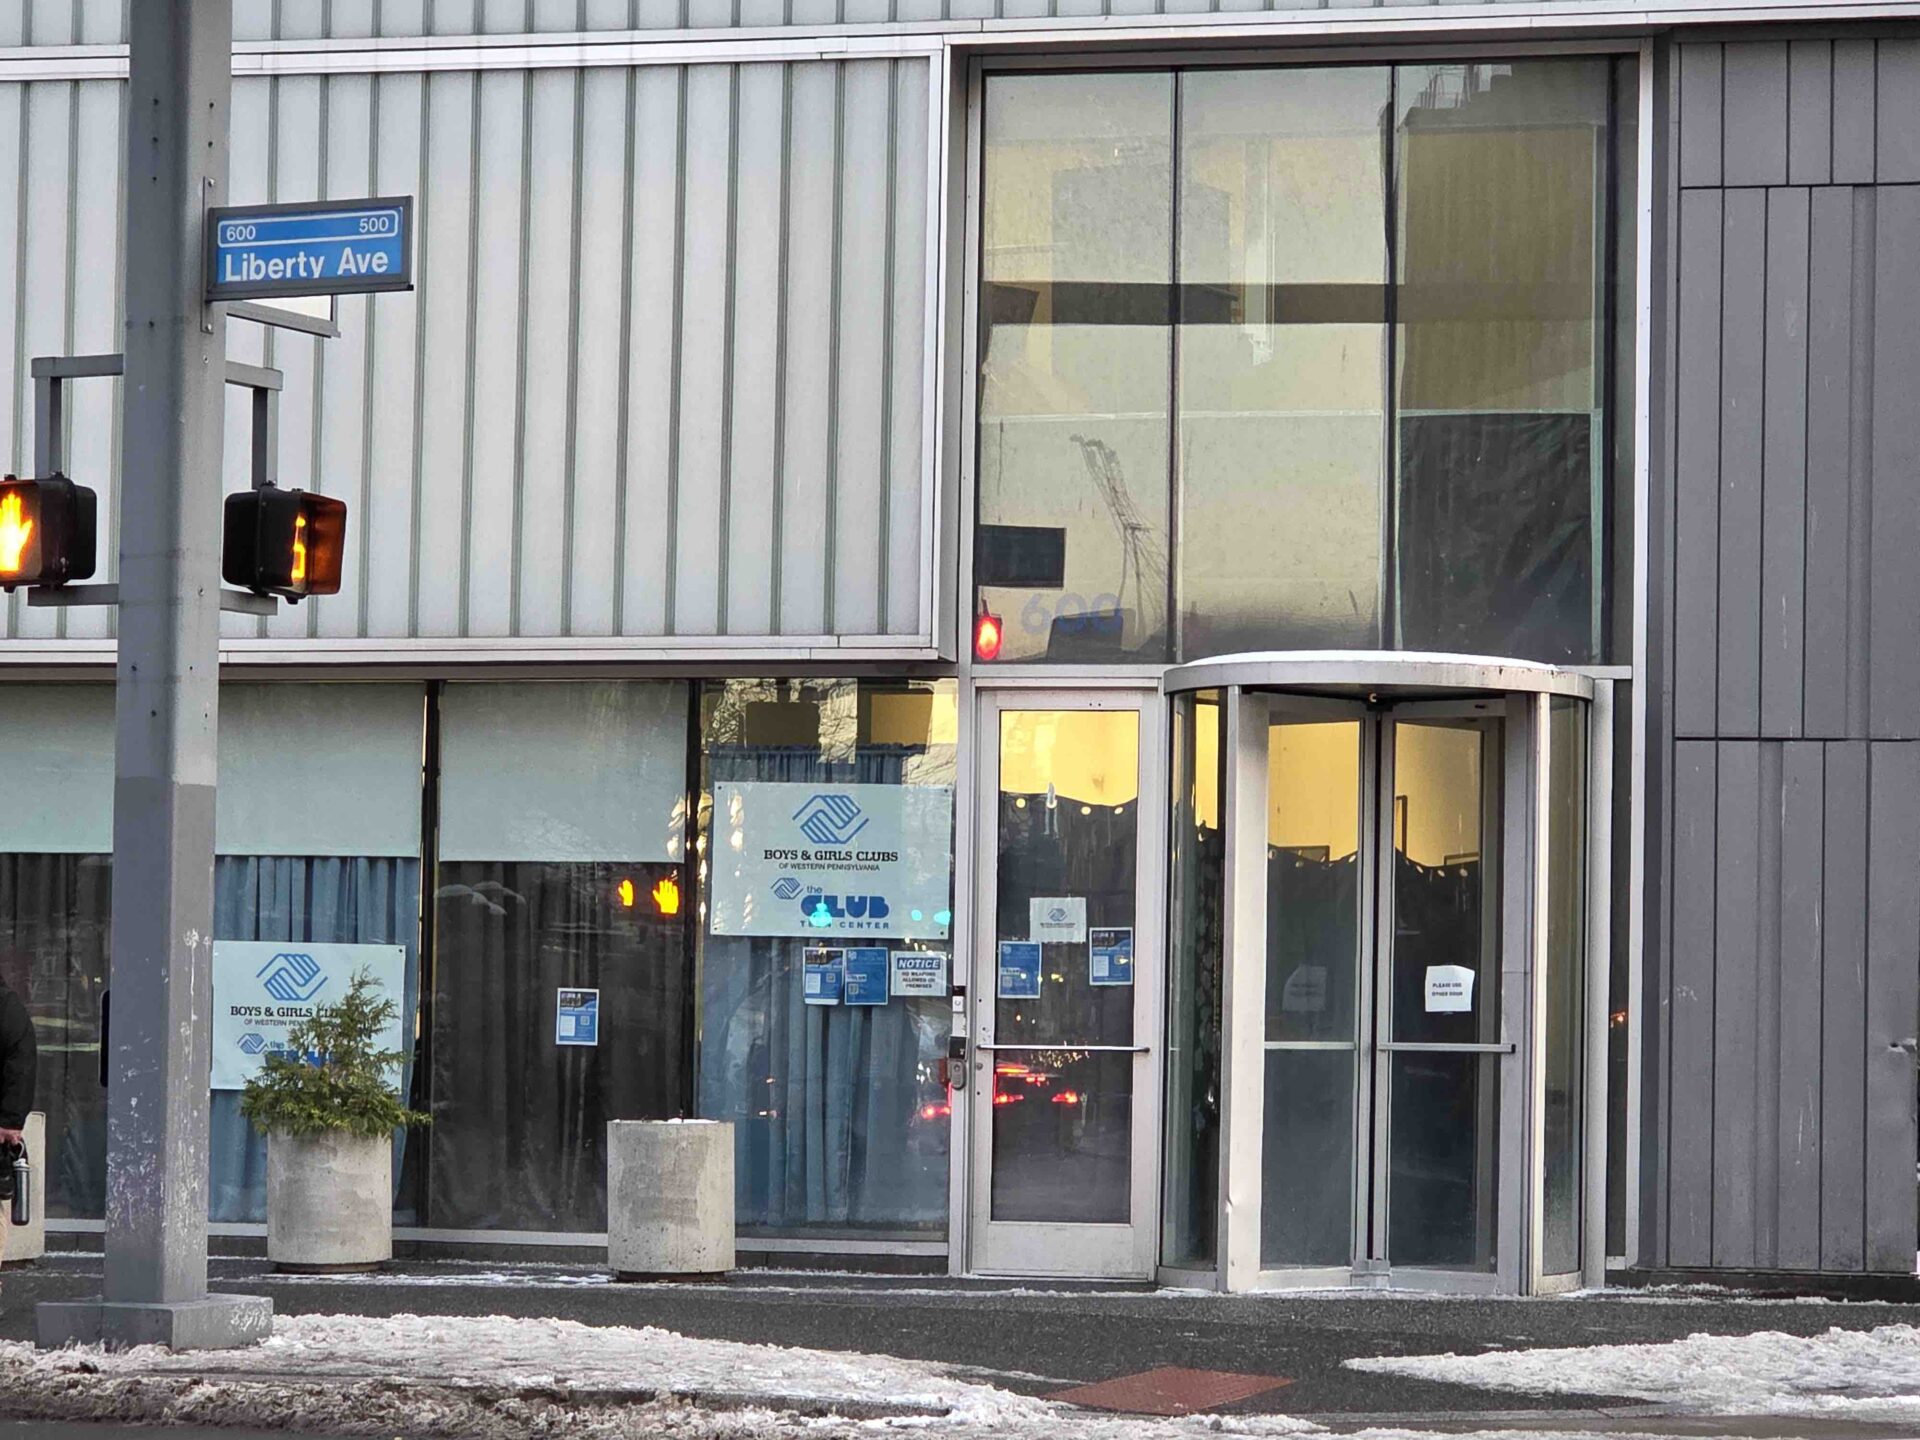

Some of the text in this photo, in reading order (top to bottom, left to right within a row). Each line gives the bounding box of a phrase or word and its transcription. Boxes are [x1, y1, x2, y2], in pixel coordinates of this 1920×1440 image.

[226, 217, 389, 241] 600 500
[225, 247, 389, 281] Liberty Ave
[764, 849, 898, 862] BOYS & GIRLS CLUBS
[827, 863, 880, 871] PENNSYLVANIA
[807, 885, 823, 894] the
[801, 895, 889, 918] CLUB
[898, 959, 939, 968] NOTICE
[230, 1006, 261, 1016] BOYS
[264, 1006, 274, 1017] &
[277, 1007, 313, 1017] GIRLS
